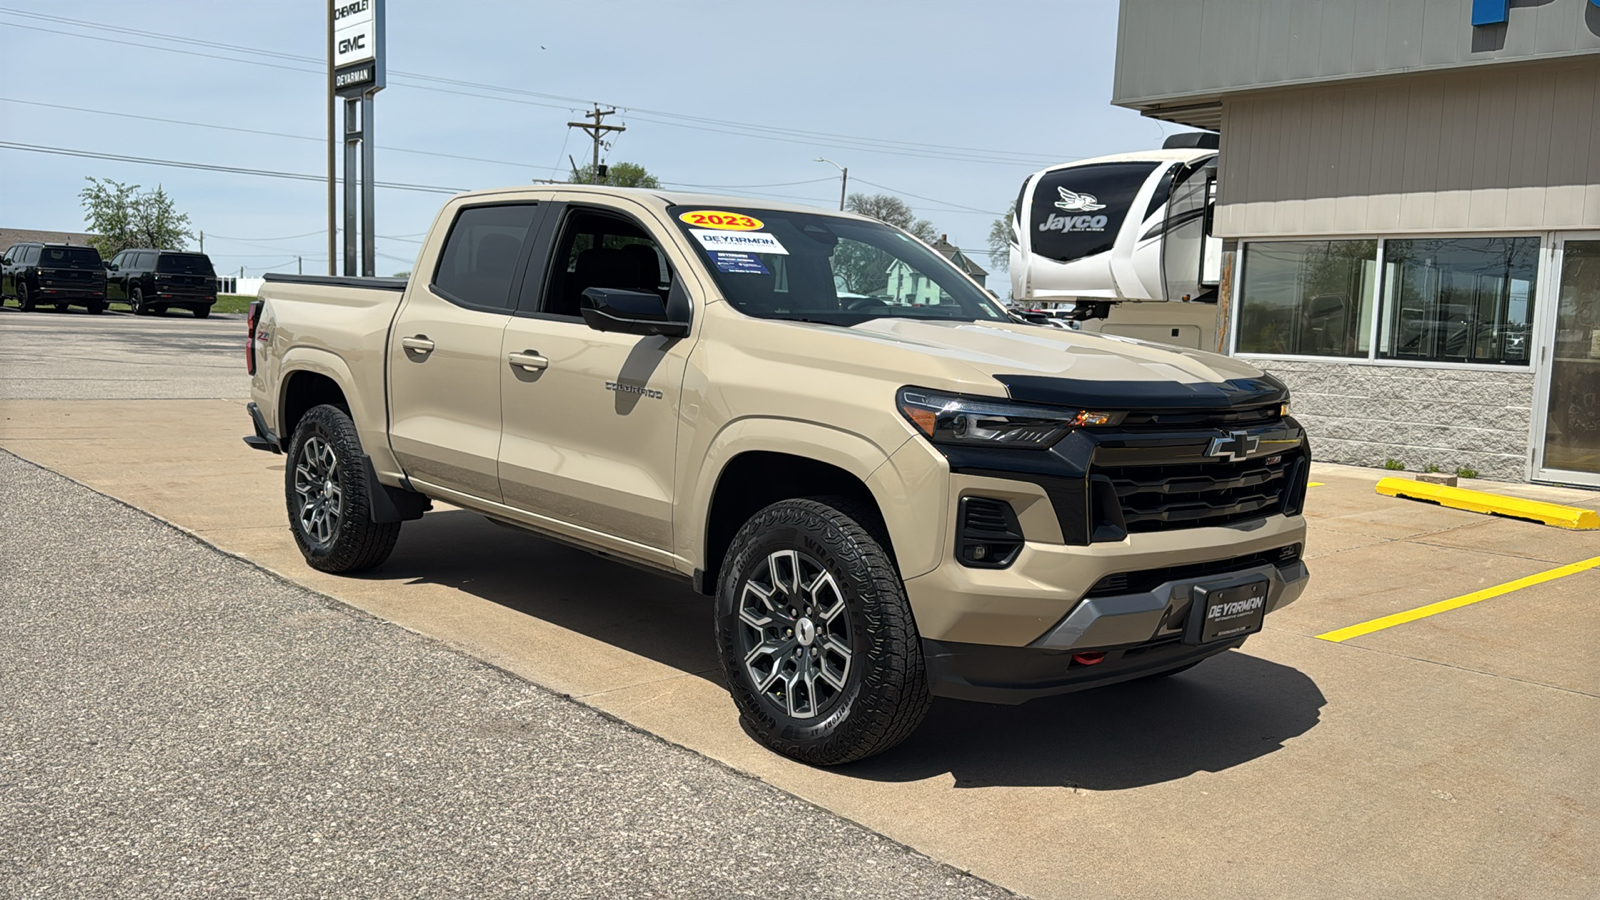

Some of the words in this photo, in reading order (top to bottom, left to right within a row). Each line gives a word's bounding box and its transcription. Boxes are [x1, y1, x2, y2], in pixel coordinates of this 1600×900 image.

[334, 0, 369, 20] CHEVROLET
[338, 33, 365, 54] GMC
[336, 69, 369, 87] DEYARMAN
[690, 214, 757, 227] 2023
[1038, 212, 1108, 234] Jayco
[702, 234, 775, 245] DEYARMAN
[604, 381, 663, 400] COLORADO
[1207, 596, 1264, 619] DEYARMAN
